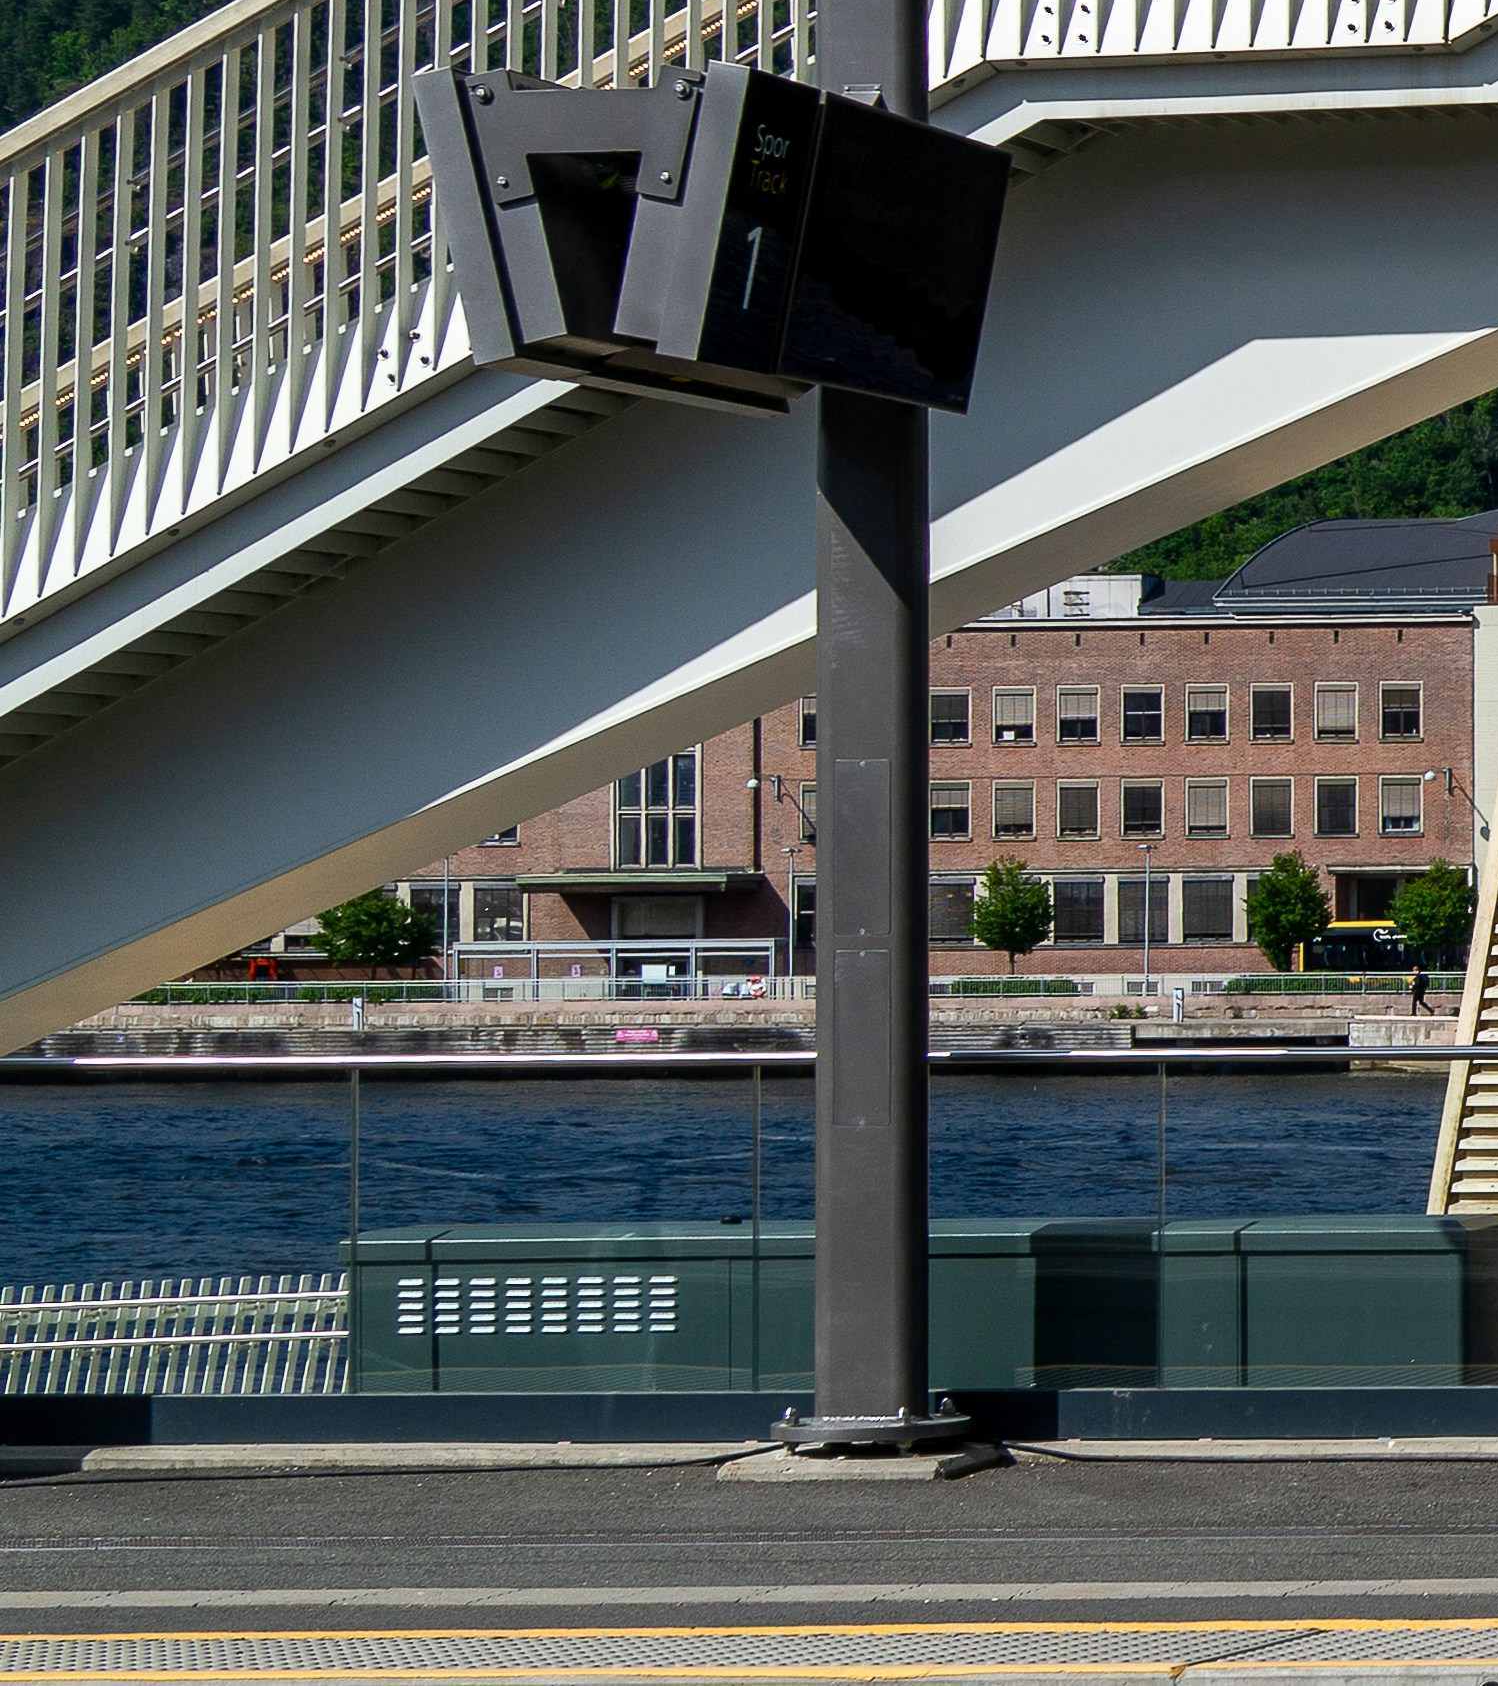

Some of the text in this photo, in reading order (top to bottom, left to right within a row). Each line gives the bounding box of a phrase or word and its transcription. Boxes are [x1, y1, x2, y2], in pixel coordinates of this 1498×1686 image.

[753, 123, 791, 162] Spor
[750, 159, 788, 196] Track
[742, 225, 764, 310] 1
